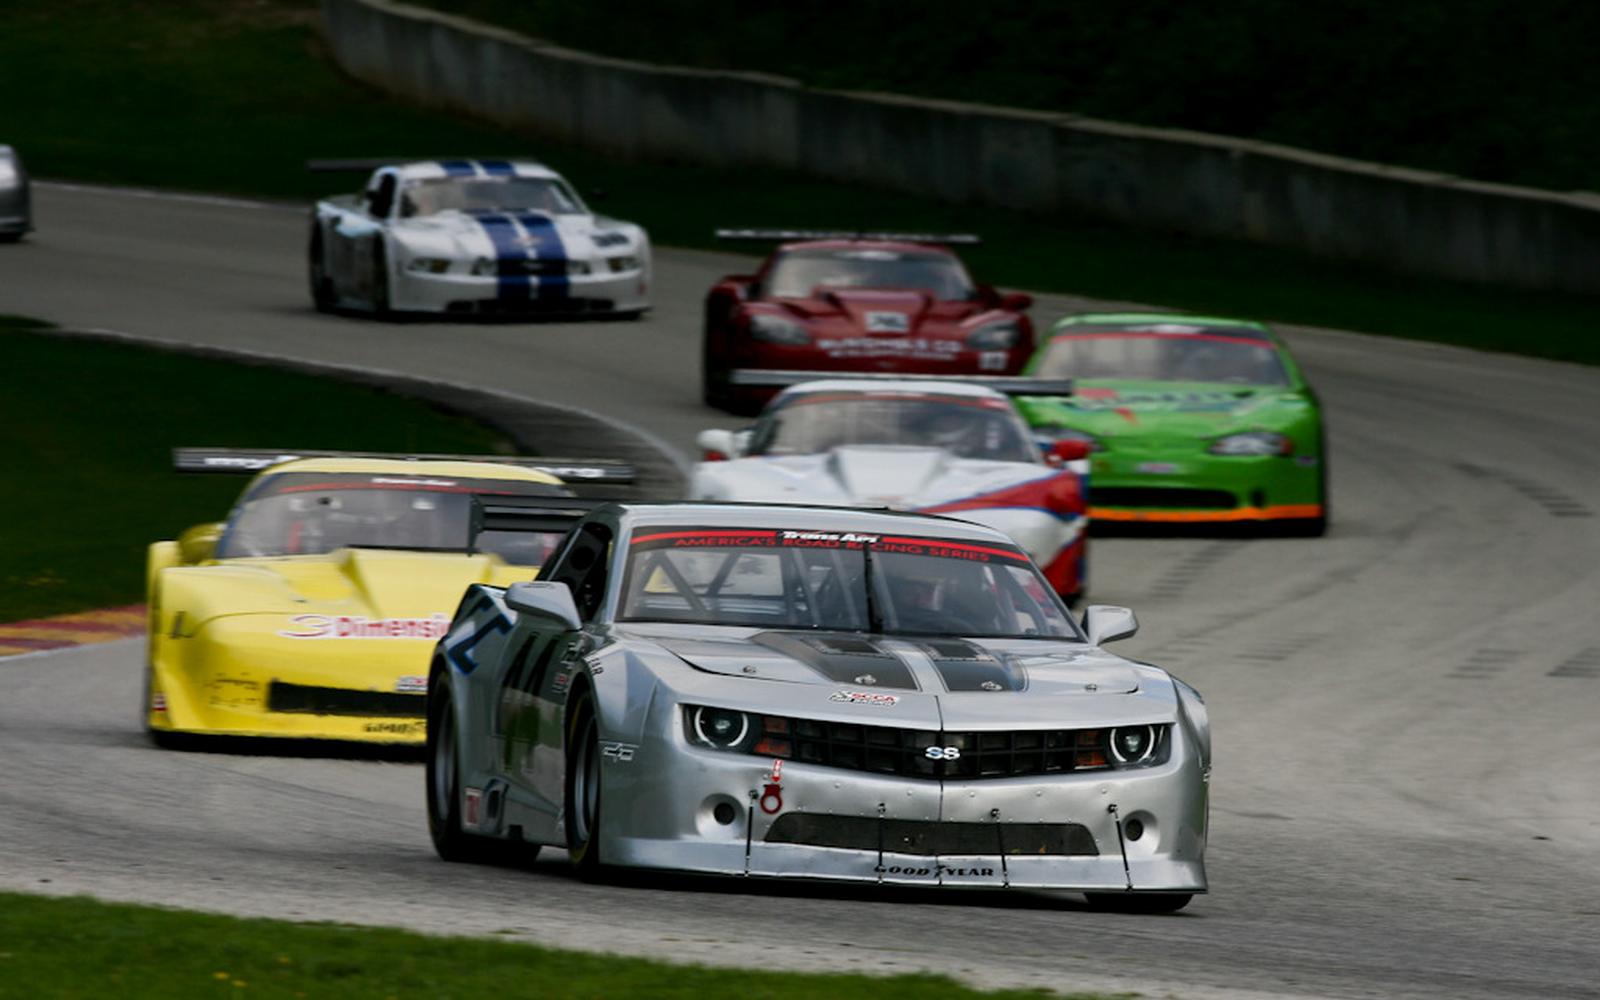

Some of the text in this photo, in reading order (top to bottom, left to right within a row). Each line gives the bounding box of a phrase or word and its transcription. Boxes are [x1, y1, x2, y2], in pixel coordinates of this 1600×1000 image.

[783, 530, 839, 541] Trans
[674, 536, 991, 563] AMERICA'S ROAD RACING SERIES
[925, 746, 960, 760] SS
